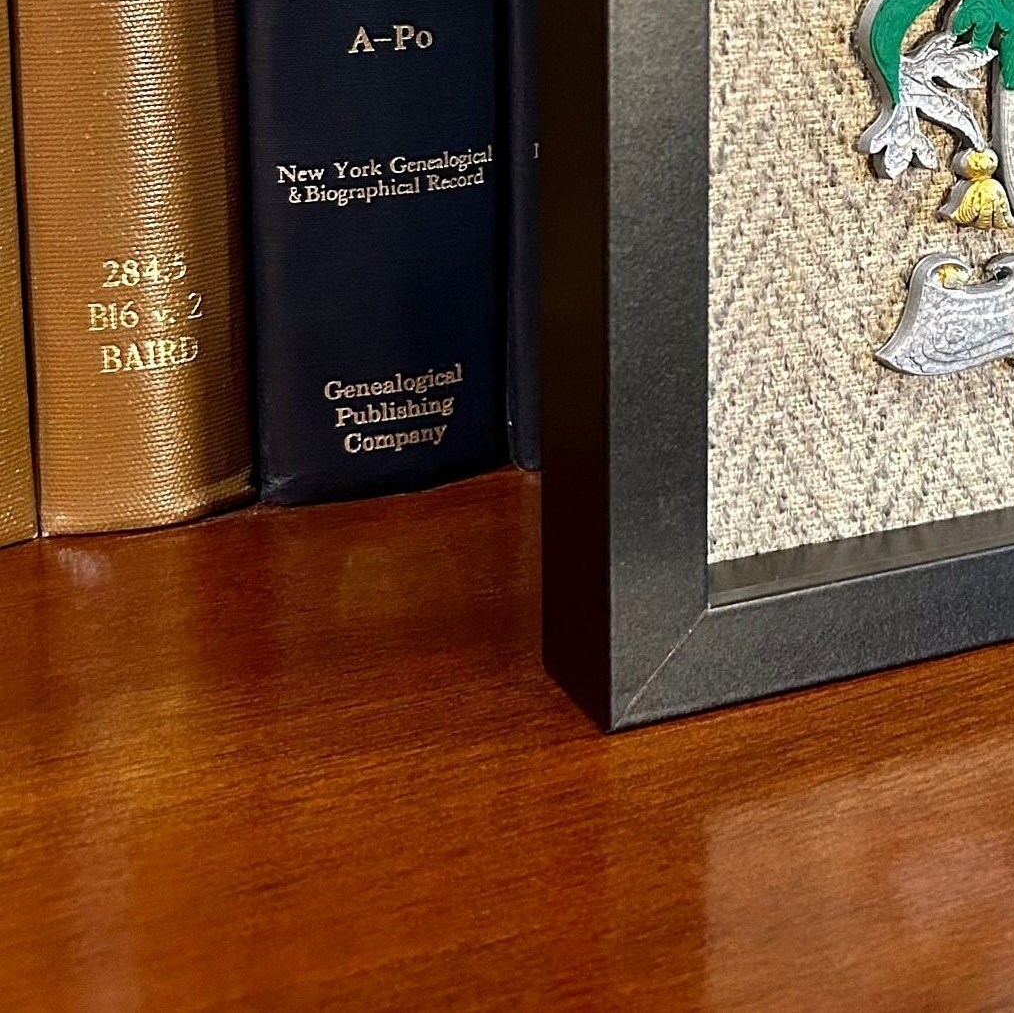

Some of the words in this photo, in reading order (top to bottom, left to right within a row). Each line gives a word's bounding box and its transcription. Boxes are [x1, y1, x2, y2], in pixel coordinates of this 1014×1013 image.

[347, 24, 433, 54] A-Po
[277, 164, 325, 184] New
[333, 159, 382, 180] York
[389, 144, 493, 175] Genealogical
[288, 187, 302, 204] &
[304, 177, 420, 207] Biographical
[426, 167, 485, 192] Record
[187, 292, 203, 319] 2
[100, 336, 199, 374] BAIRD
[324, 362, 463, 401] Genealogical
[334, 396, 454, 428] Publishing
[343, 424, 448, 454] Company
